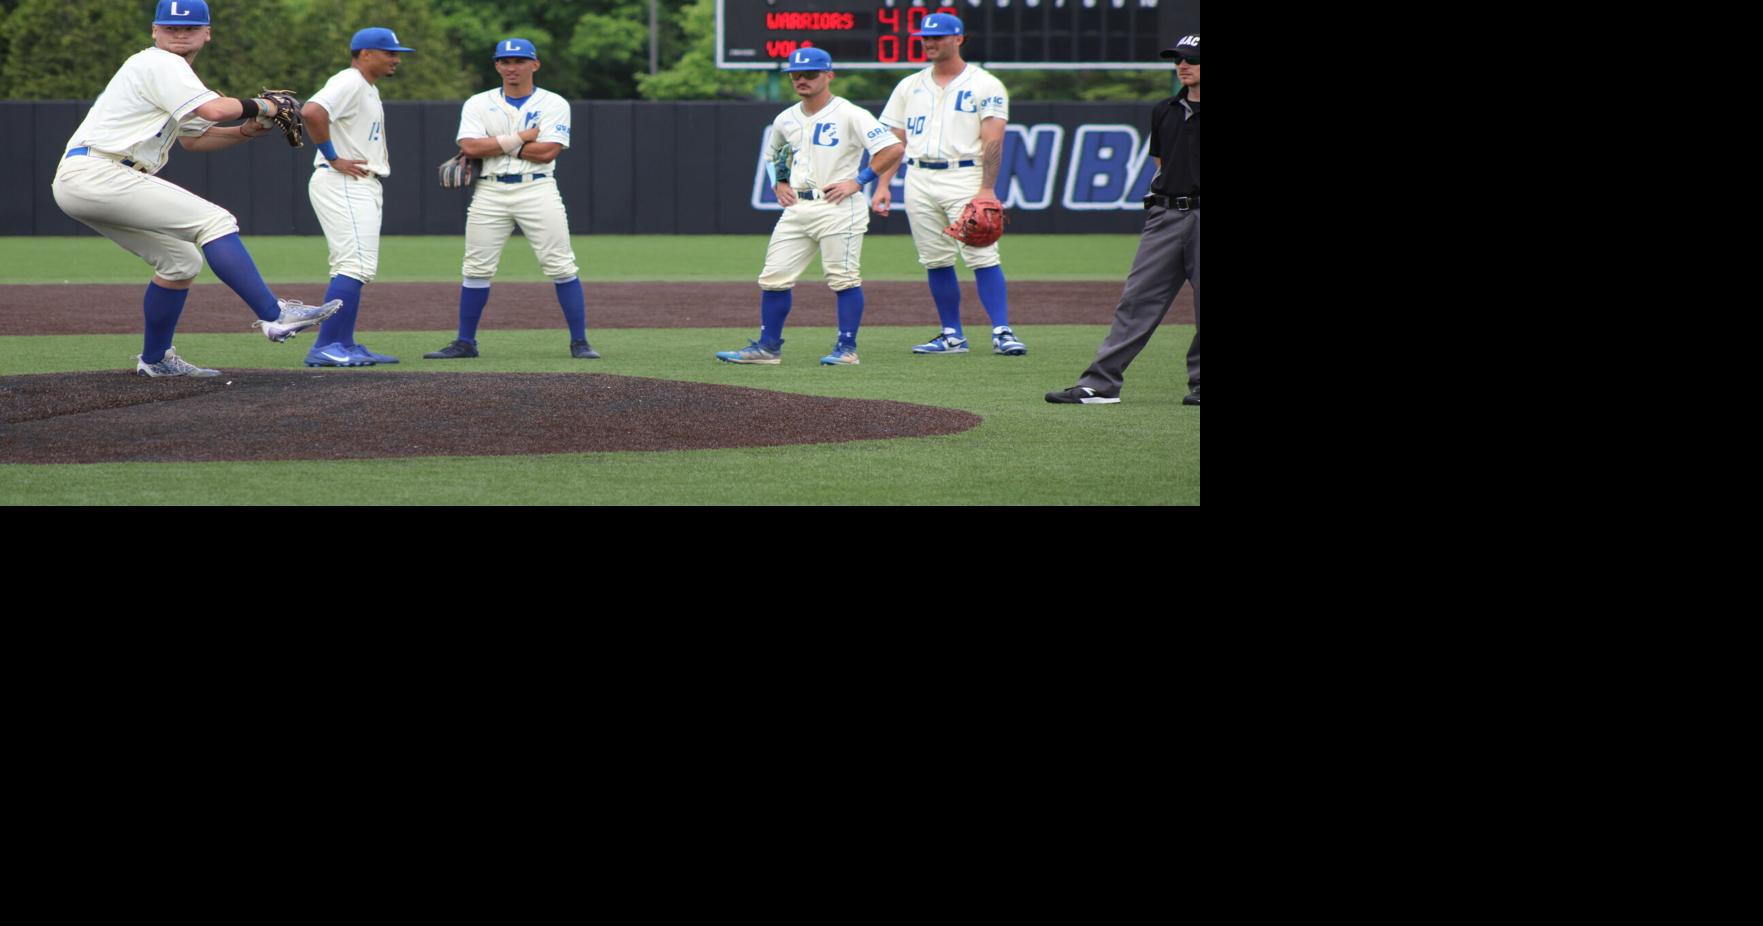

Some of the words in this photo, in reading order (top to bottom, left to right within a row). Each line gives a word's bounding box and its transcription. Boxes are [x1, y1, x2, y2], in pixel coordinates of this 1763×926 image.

[170, 1, 190, 16] L
[766, 12, 854, 30] WARRIORS
[878, 8, 899, 33] 4
[924, 17, 938, 28] L
[505, 40, 521, 51] L
[878, 35, 899, 62] 0
[795, 52, 810, 64] L
[907, 116, 926, 135] 40
